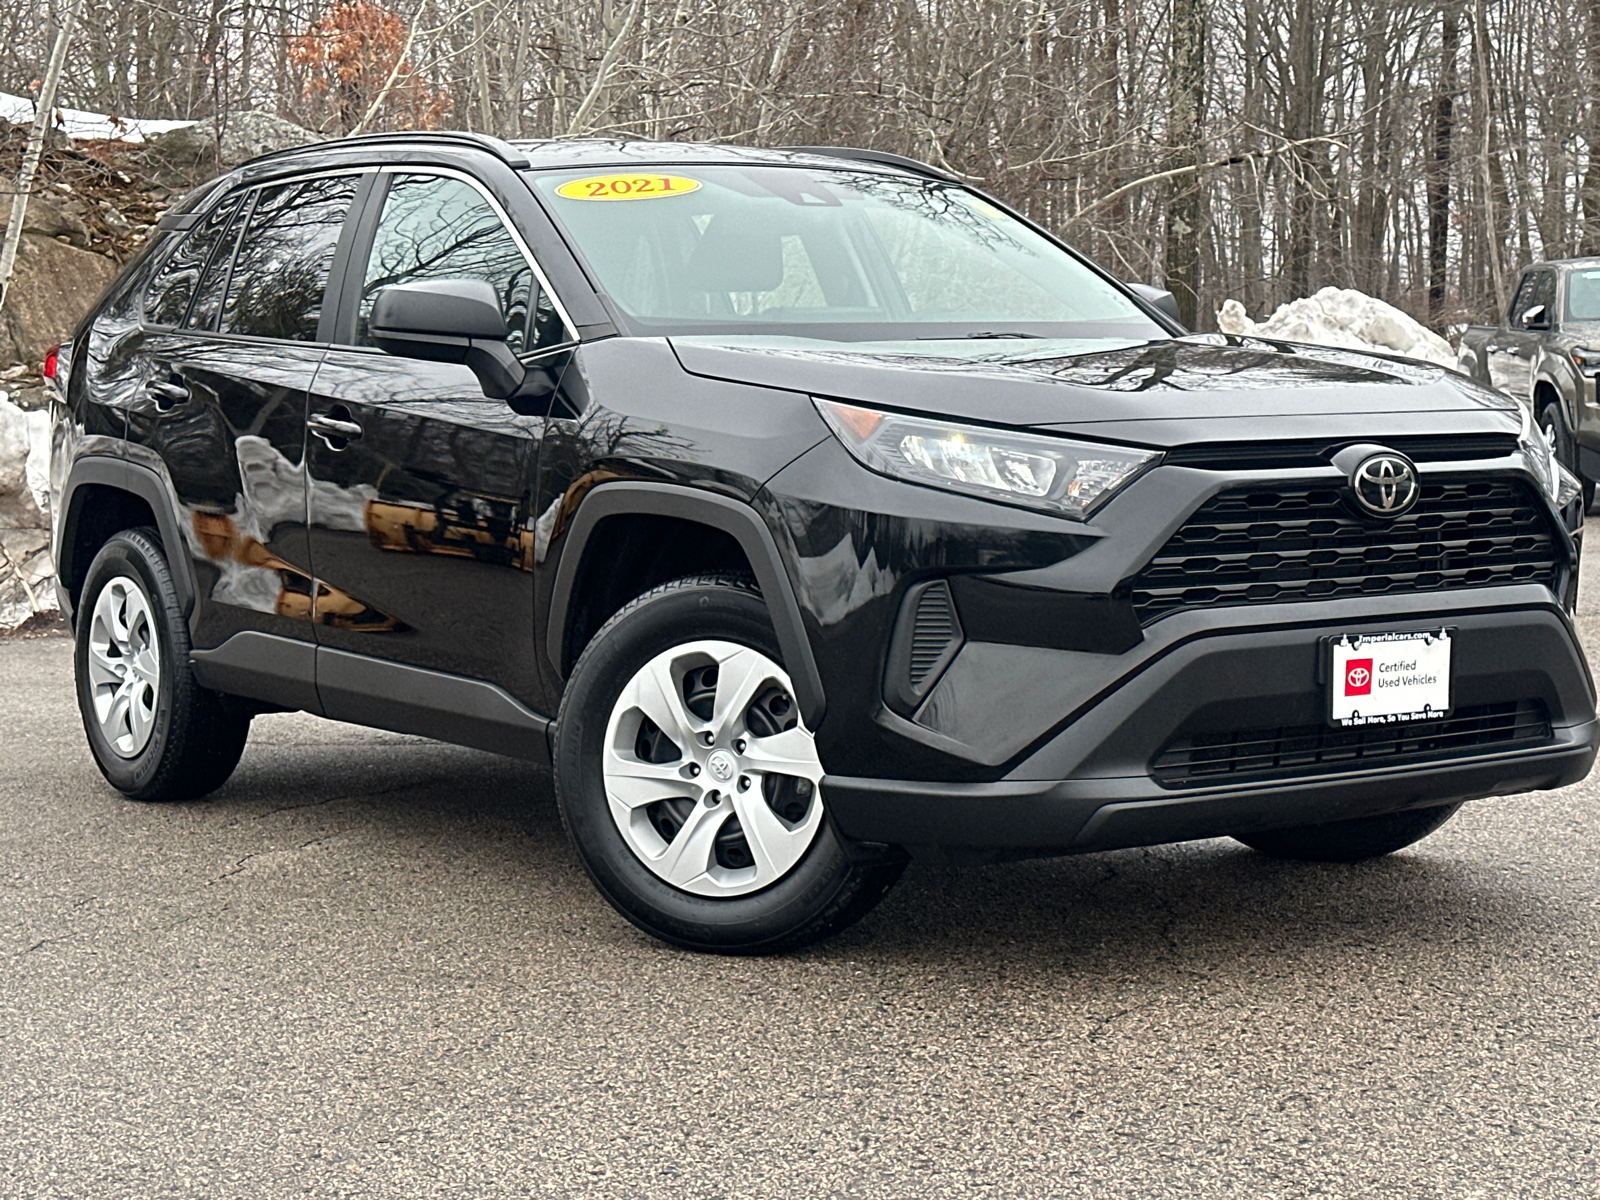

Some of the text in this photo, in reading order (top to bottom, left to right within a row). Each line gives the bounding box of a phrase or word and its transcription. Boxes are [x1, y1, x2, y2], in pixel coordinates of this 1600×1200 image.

[585, 178, 676, 197] 2021
[1379, 660, 1417, 673] Certified
[1378, 674, 1437, 688] Used Vehicles
[1341, 718, 1353, 727] We
[1354, 716, 1367, 726] Sell
[1387, 714, 1396, 722] So
[1398, 713, 1410, 722] You
[1411, 711, 1427, 720] Save
[1427, 710, 1444, 718] More
